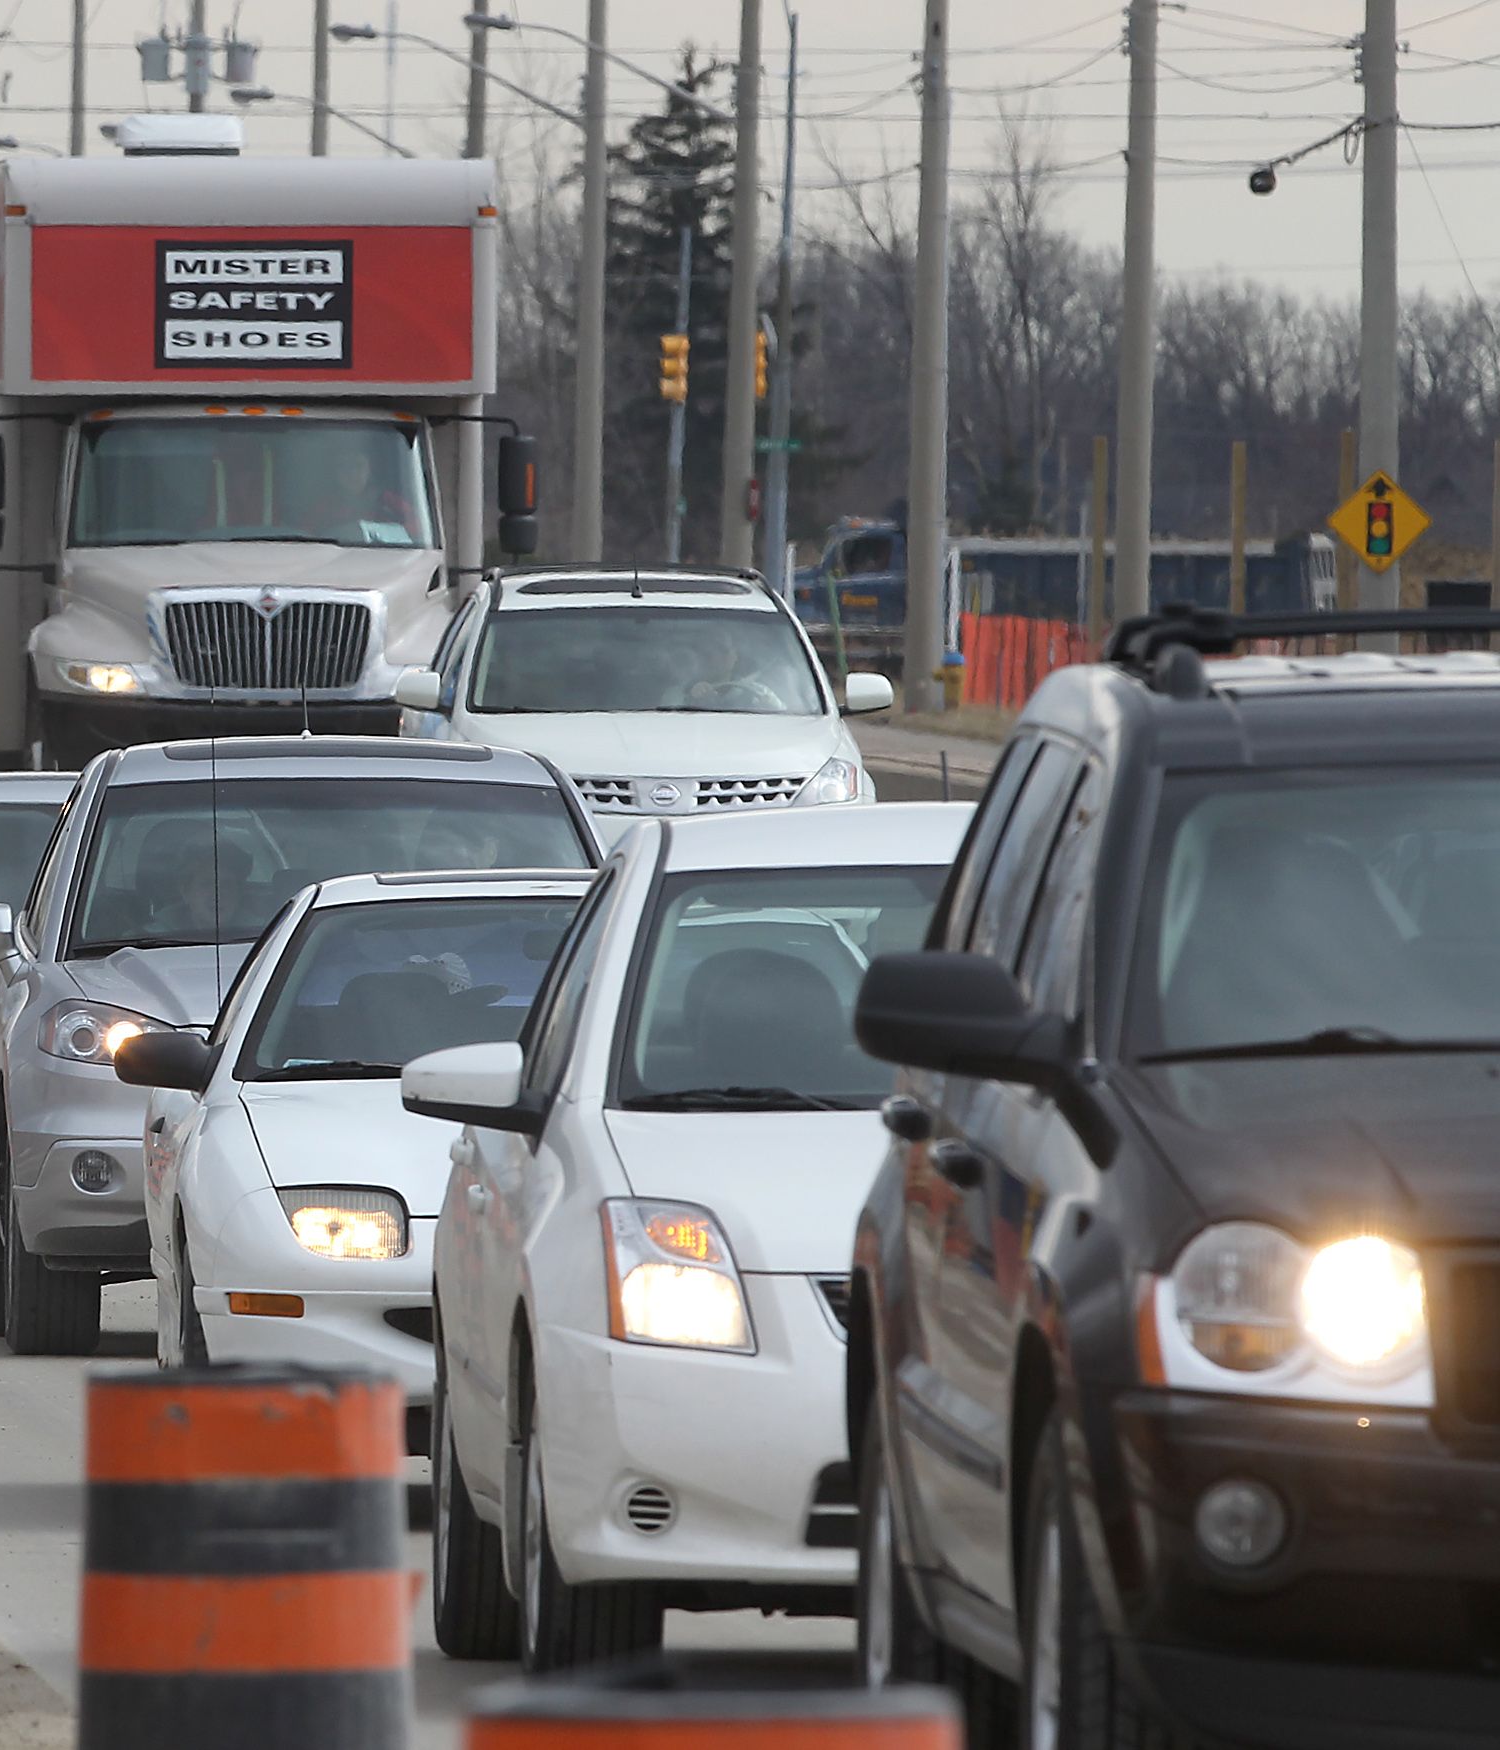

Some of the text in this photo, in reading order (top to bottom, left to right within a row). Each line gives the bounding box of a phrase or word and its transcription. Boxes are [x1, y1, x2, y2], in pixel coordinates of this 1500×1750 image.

[174, 259, 331, 275] MISTER
[168, 291, 335, 311] SAFETY
[171, 331, 332, 348] SHOES
